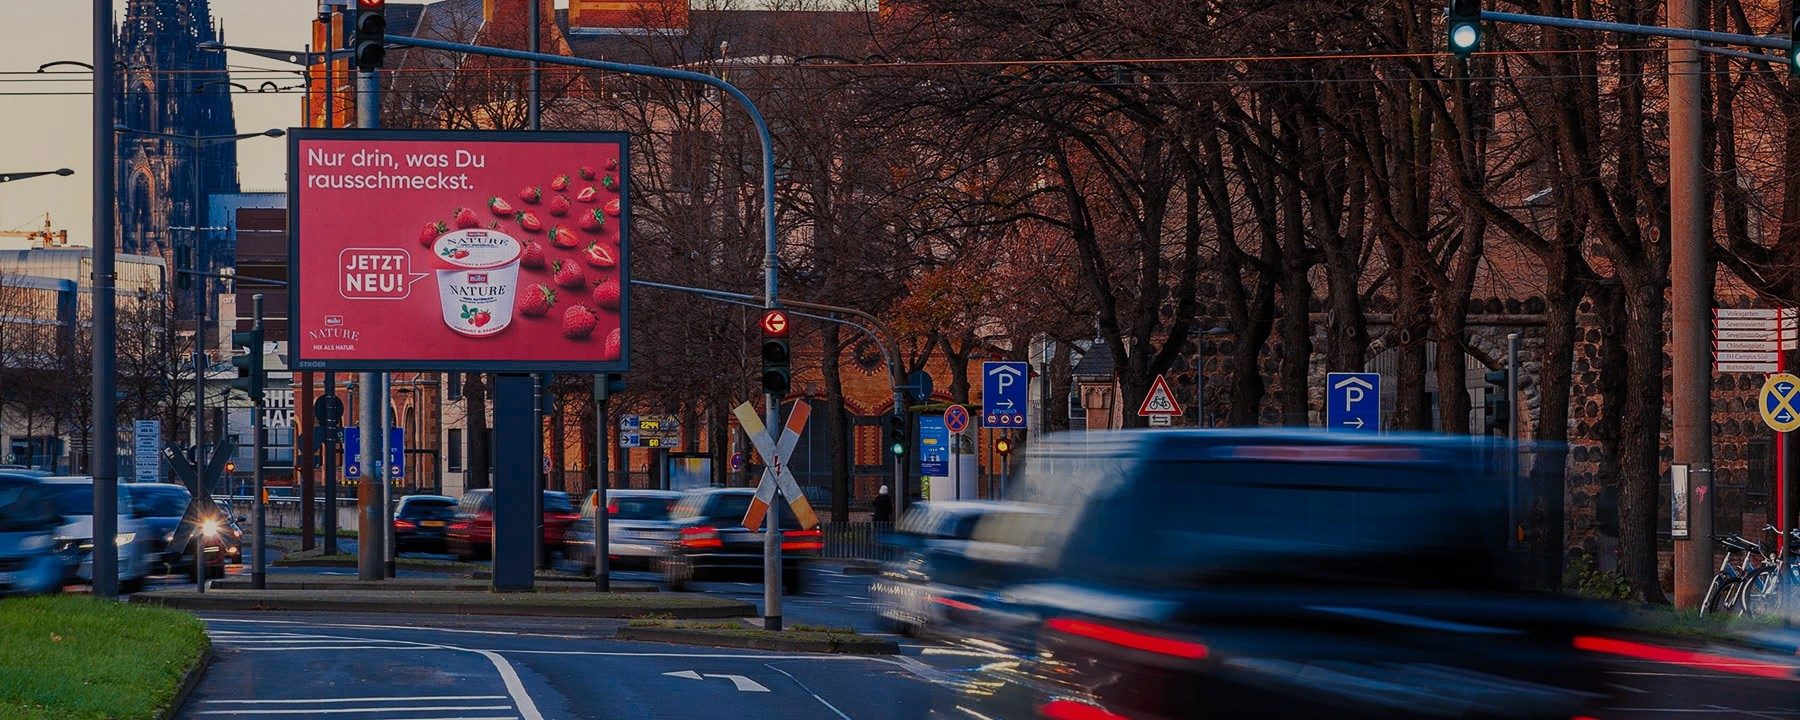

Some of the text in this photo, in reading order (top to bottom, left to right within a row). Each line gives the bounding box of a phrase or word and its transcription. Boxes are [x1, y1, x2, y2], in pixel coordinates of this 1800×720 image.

[308, 149, 485, 170] Nur drin, was Du
[308, 171, 474, 190] rausschmeckst.
[447, 237, 509, 246] NATURE
[346, 255, 404, 270] JETZT
[346, 273, 404, 293] NEU!
[449, 284, 507, 296] NATURE
[309, 328, 360, 341] NATURE
[1735, 353, 1757, 361] Campus
[998, 373, 1014, 395] P
[1346, 386, 1364, 412] P
